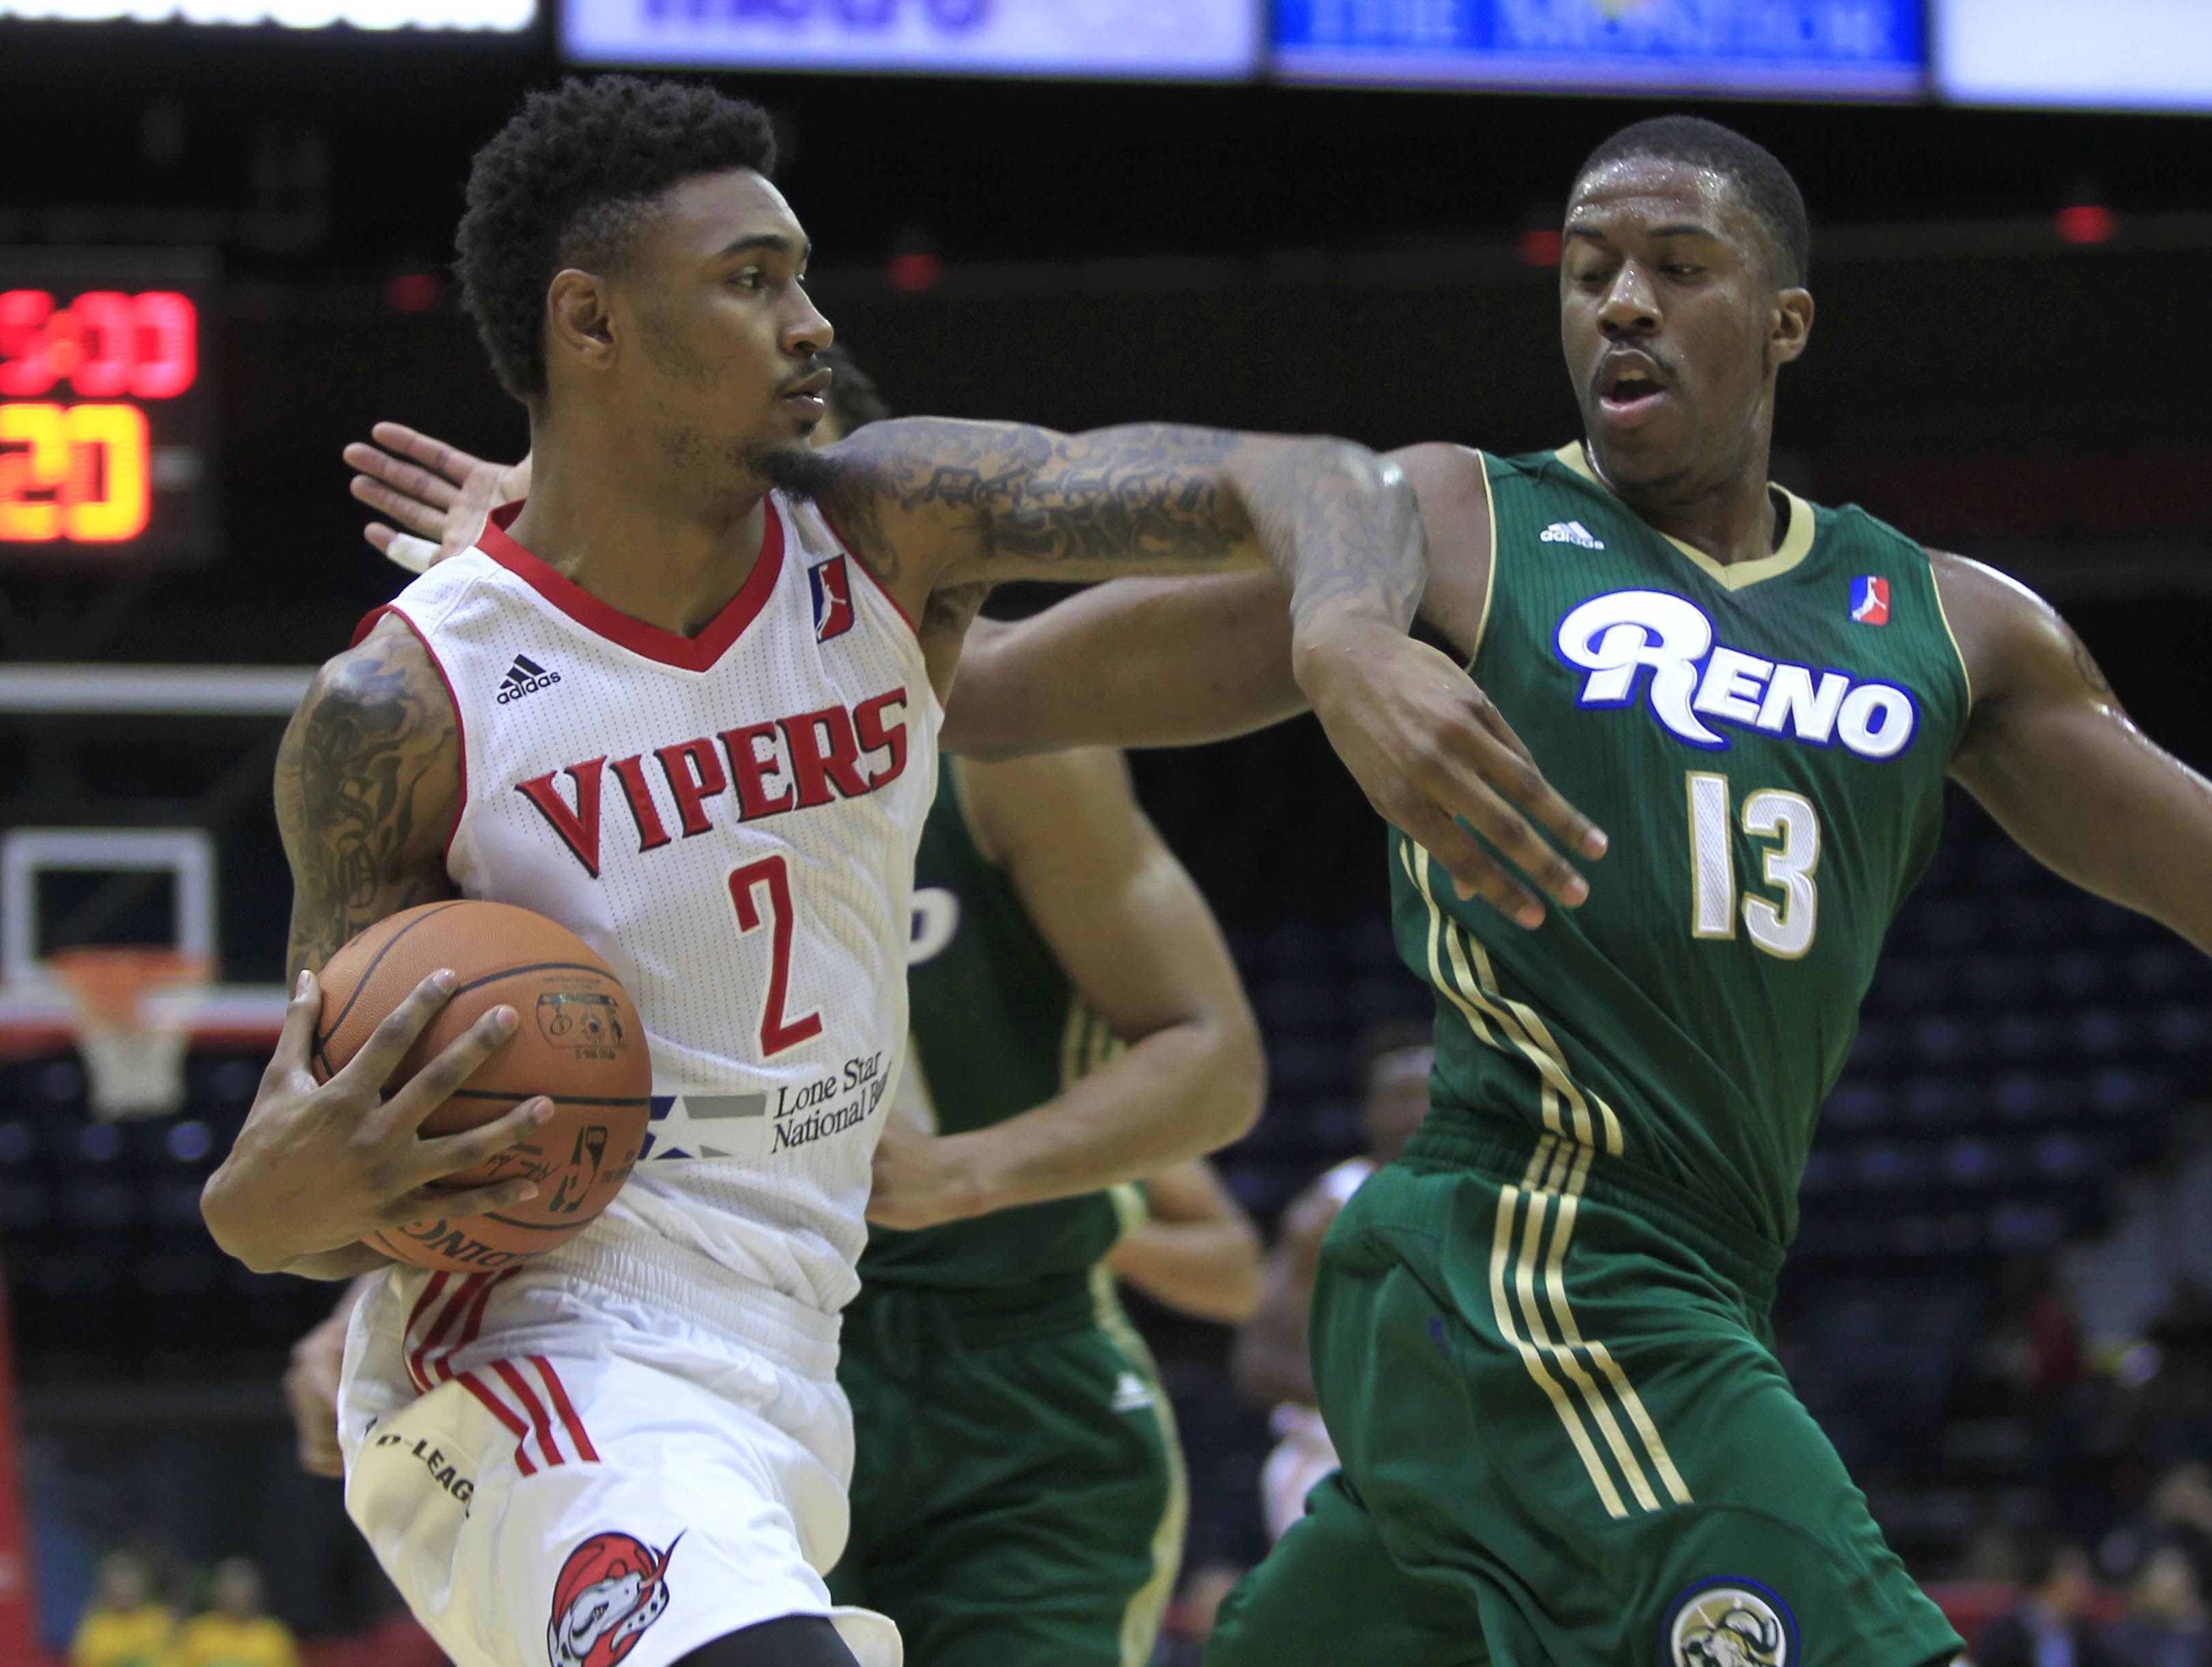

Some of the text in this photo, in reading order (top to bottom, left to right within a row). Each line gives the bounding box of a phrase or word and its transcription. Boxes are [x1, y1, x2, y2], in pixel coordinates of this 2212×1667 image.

[496, 672, 561, 704] adidas
[1555, 588, 1916, 758] RENO
[515, 687, 907, 880] VIPERS
[1686, 770, 1819, 960] 13
[728, 855, 823, 1057] 2
[771, 1088, 865, 1154] National
[774, 1076, 837, 1119] Lone
[843, 1051, 882, 1094] Star
